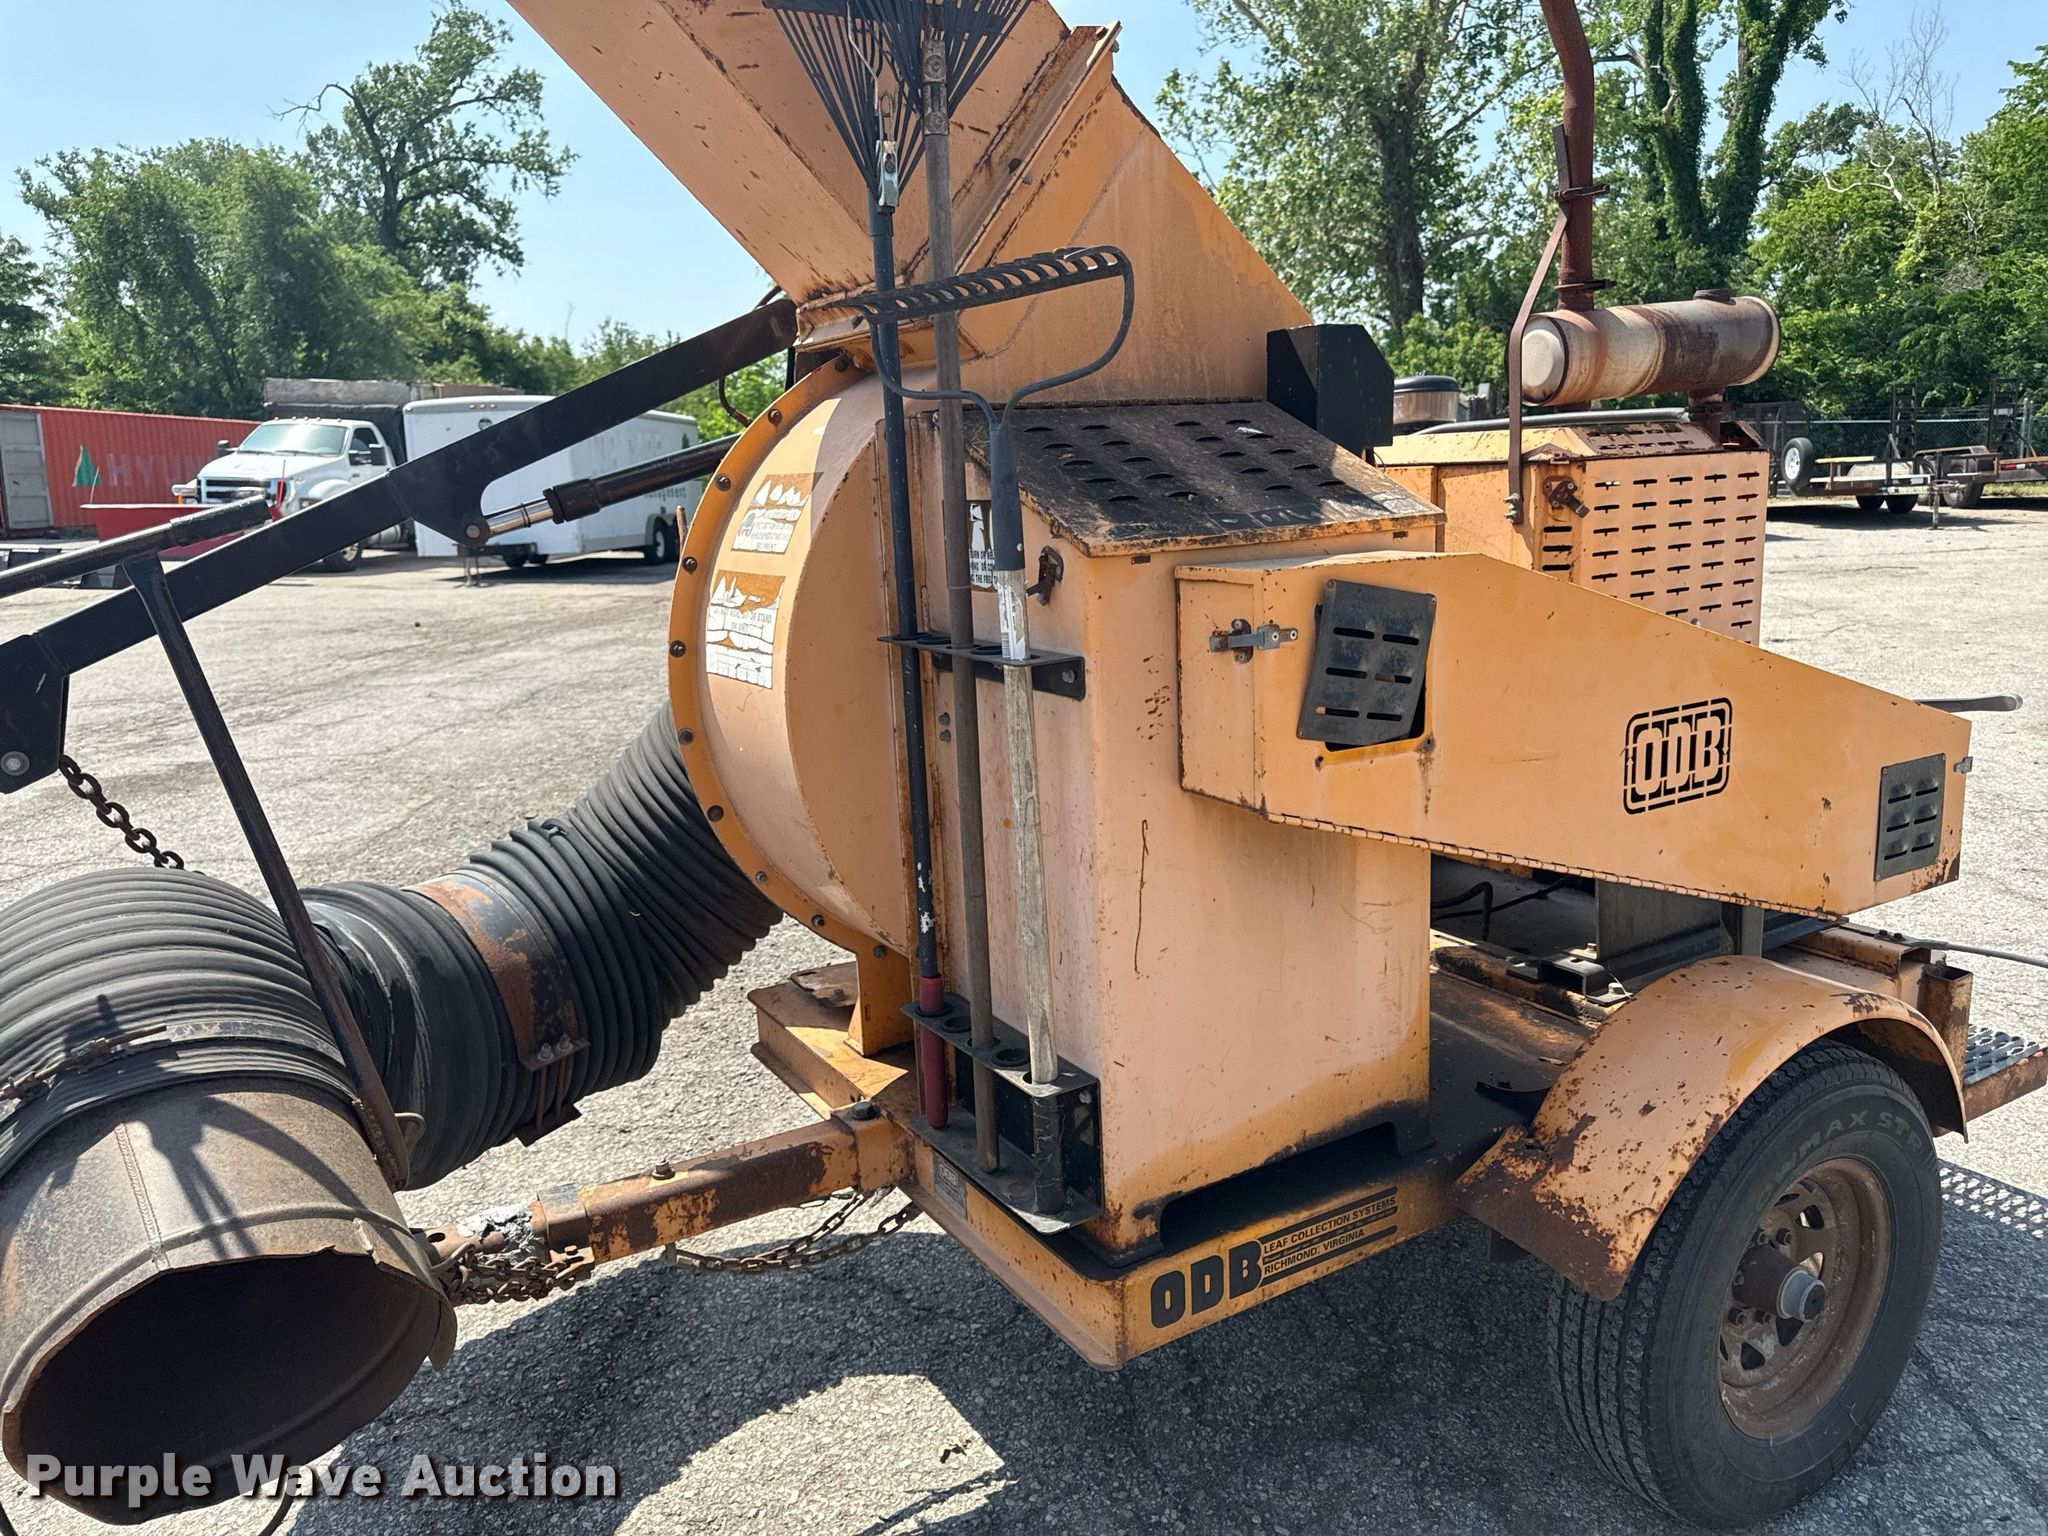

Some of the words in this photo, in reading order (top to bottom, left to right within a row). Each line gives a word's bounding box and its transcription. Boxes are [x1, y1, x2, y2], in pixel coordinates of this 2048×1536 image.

[1635, 715, 1722, 796] ODB
[1263, 1238, 1288, 1254] LEAF
[1291, 1214, 1350, 1243] COLLECTION
[1352, 1196, 1396, 1220] SYSTEMS
[1263, 1247, 1321, 1275] RICHMOND,
[1323, 1229, 1365, 1251] VIRGINIA
[1150, 1240, 1263, 1329] ODB
